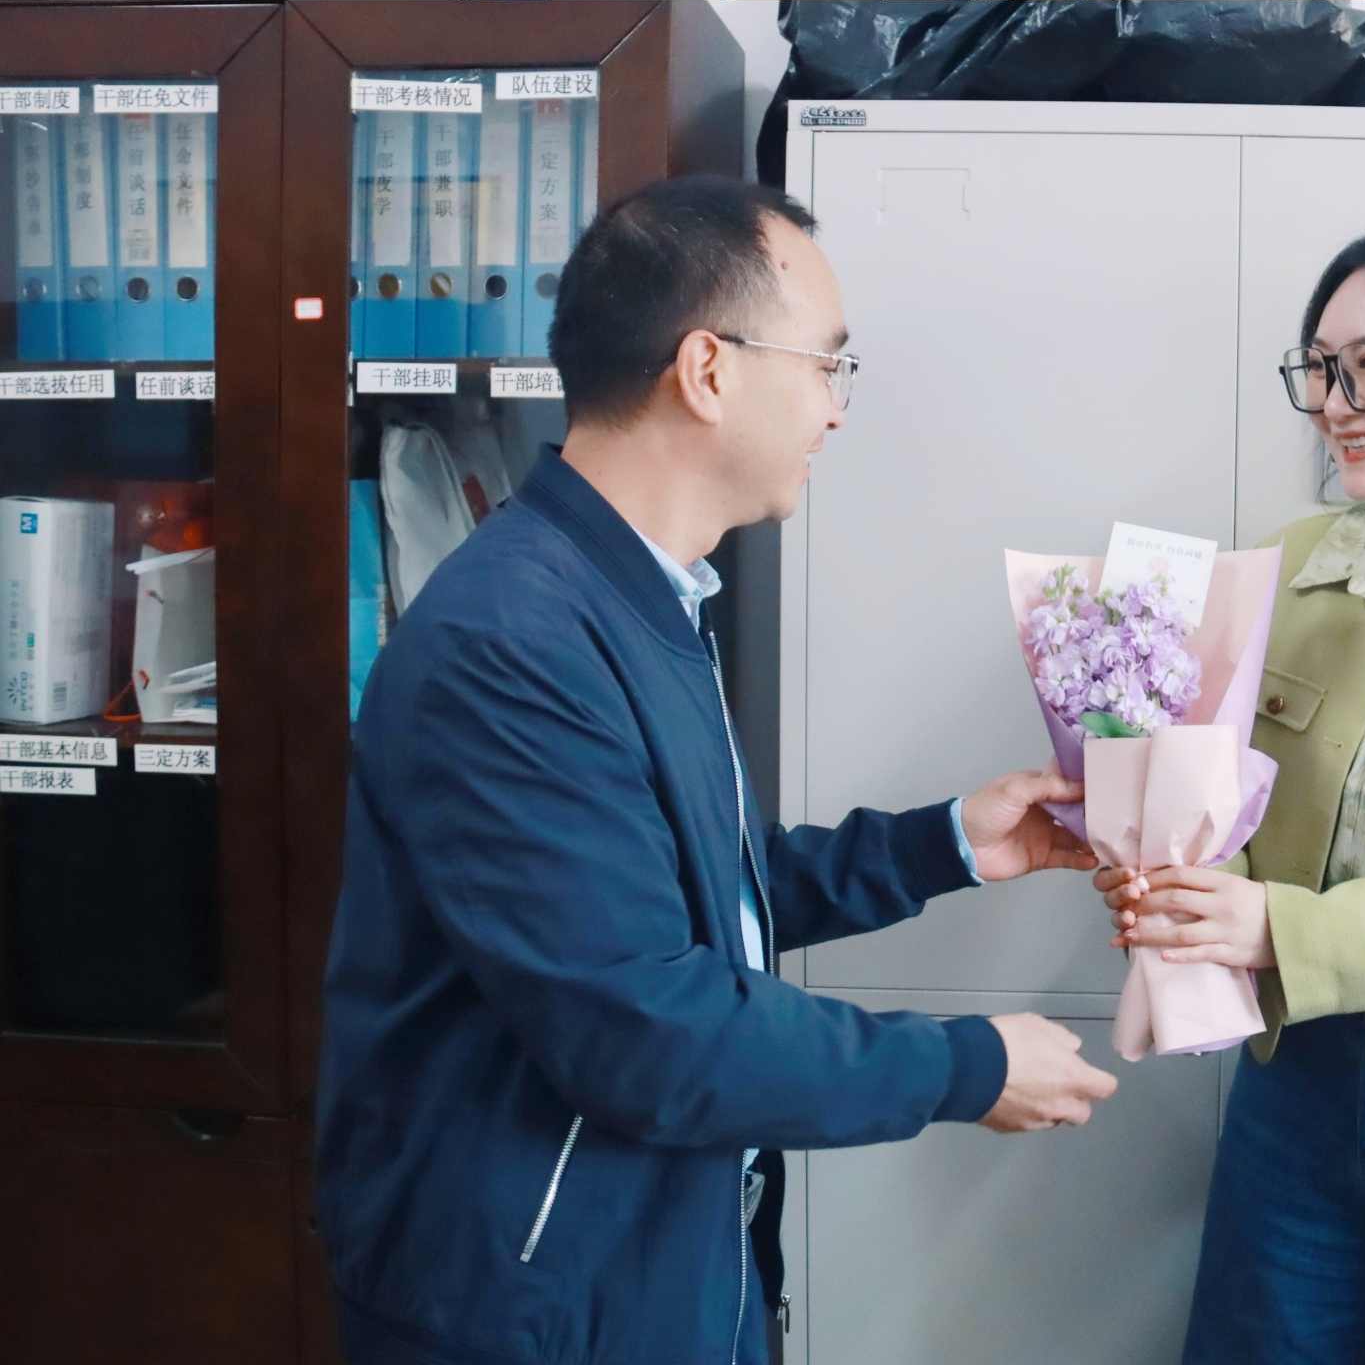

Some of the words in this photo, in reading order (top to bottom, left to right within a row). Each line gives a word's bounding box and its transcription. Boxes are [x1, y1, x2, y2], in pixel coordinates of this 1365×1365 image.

[355, 84, 474, 108] 干部考核情况
[511, 72, 594, 96] 队伍建设
[96, 86, 210, 110] 干部任免文件
[0, 372, 105, 396] 干部选拔任用
[139, 372, 215, 397] 任前谈话
[372, 367, 453, 389] 干部挂职
[0, 739, 109, 761] 干部基本信息
[138, 748, 213, 771] 三定方案
[0, 768, 75, 791] 干部报表
